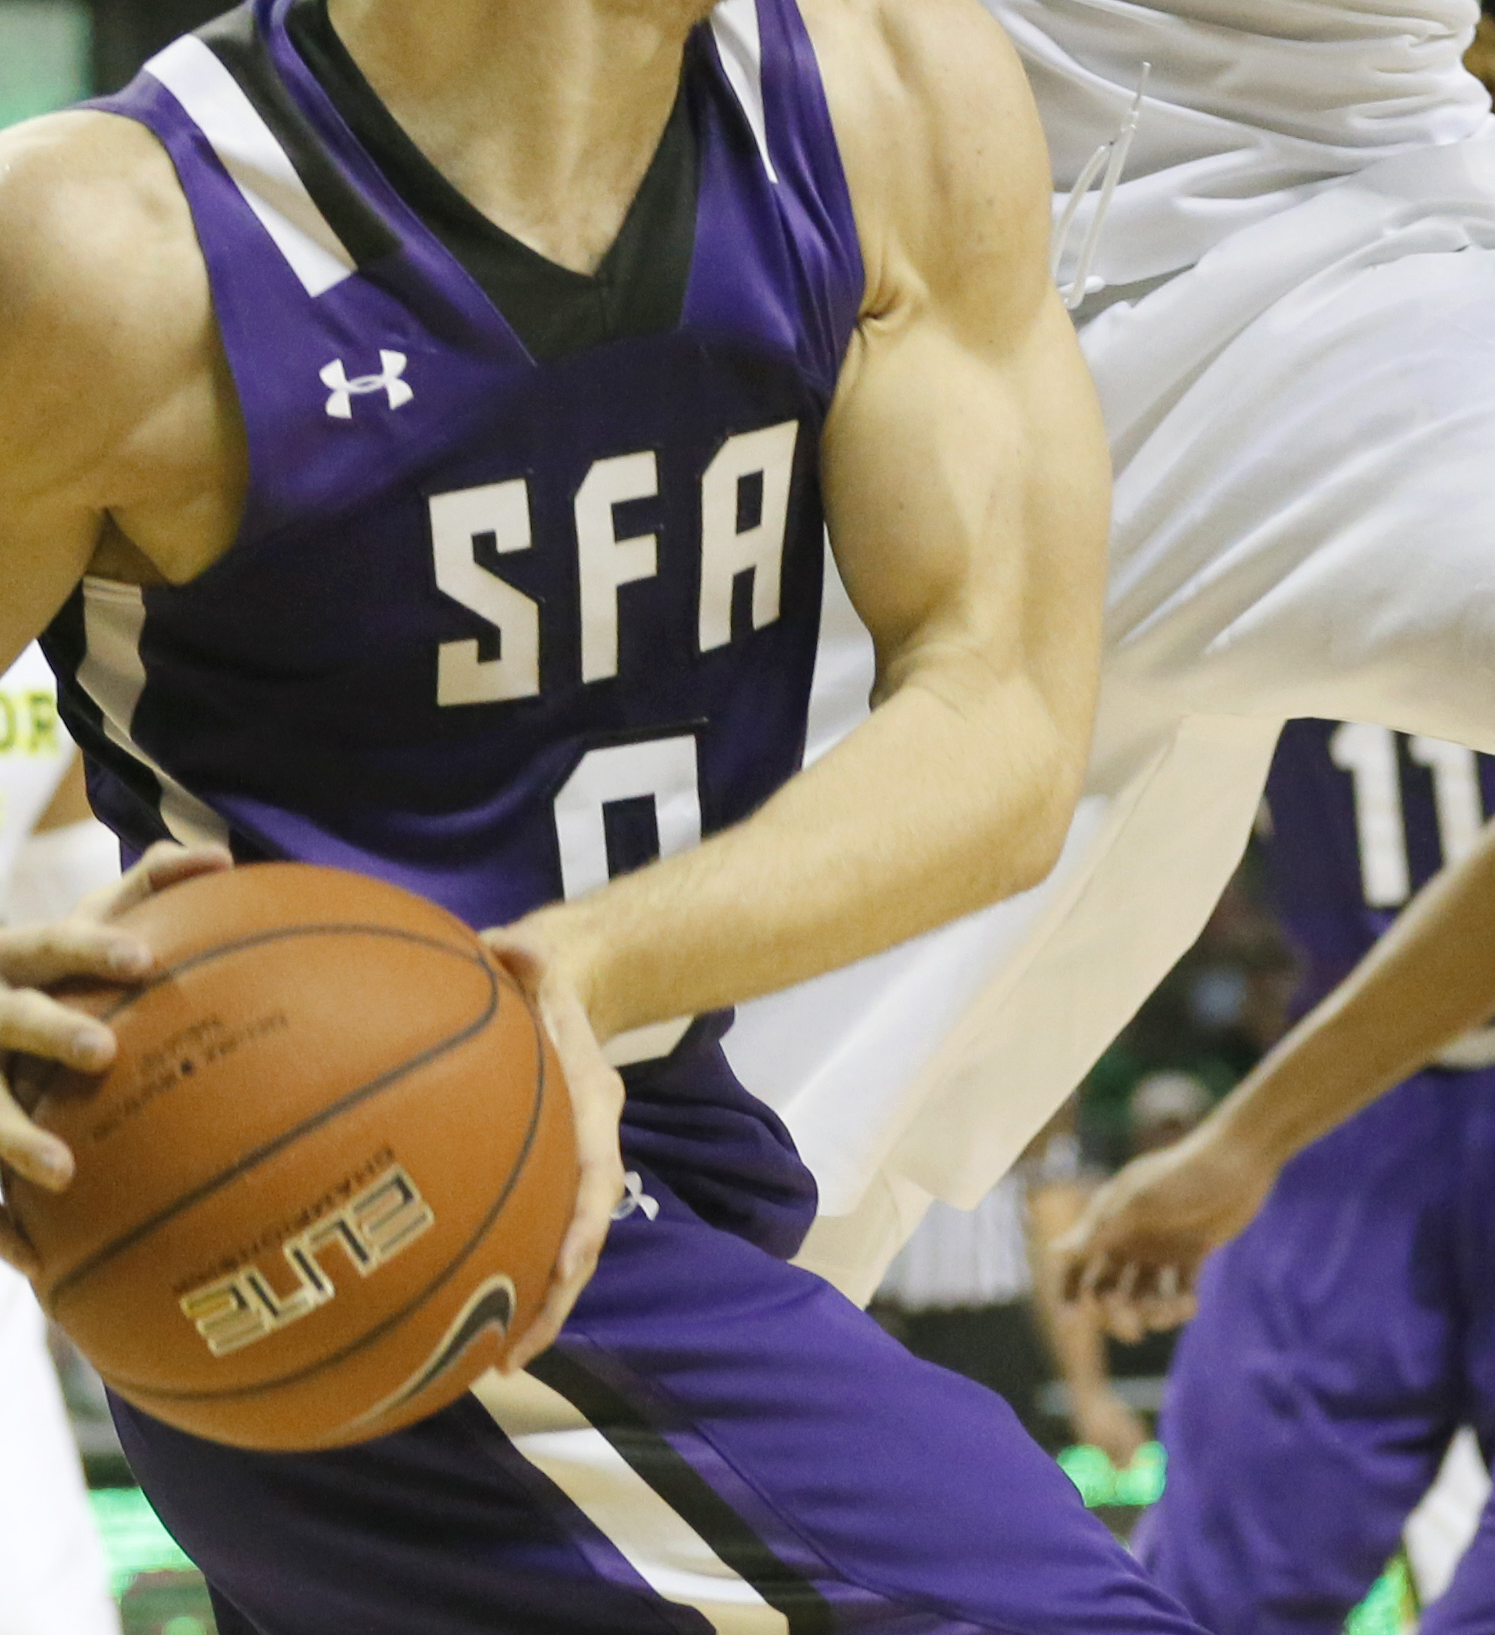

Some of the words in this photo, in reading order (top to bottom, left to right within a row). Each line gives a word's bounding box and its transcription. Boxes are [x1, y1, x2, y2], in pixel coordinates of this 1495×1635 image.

[428, 418, 799, 707] SFA
[1328, 723, 1490, 908] 11
[179, 1163, 435, 1357] ELITE
